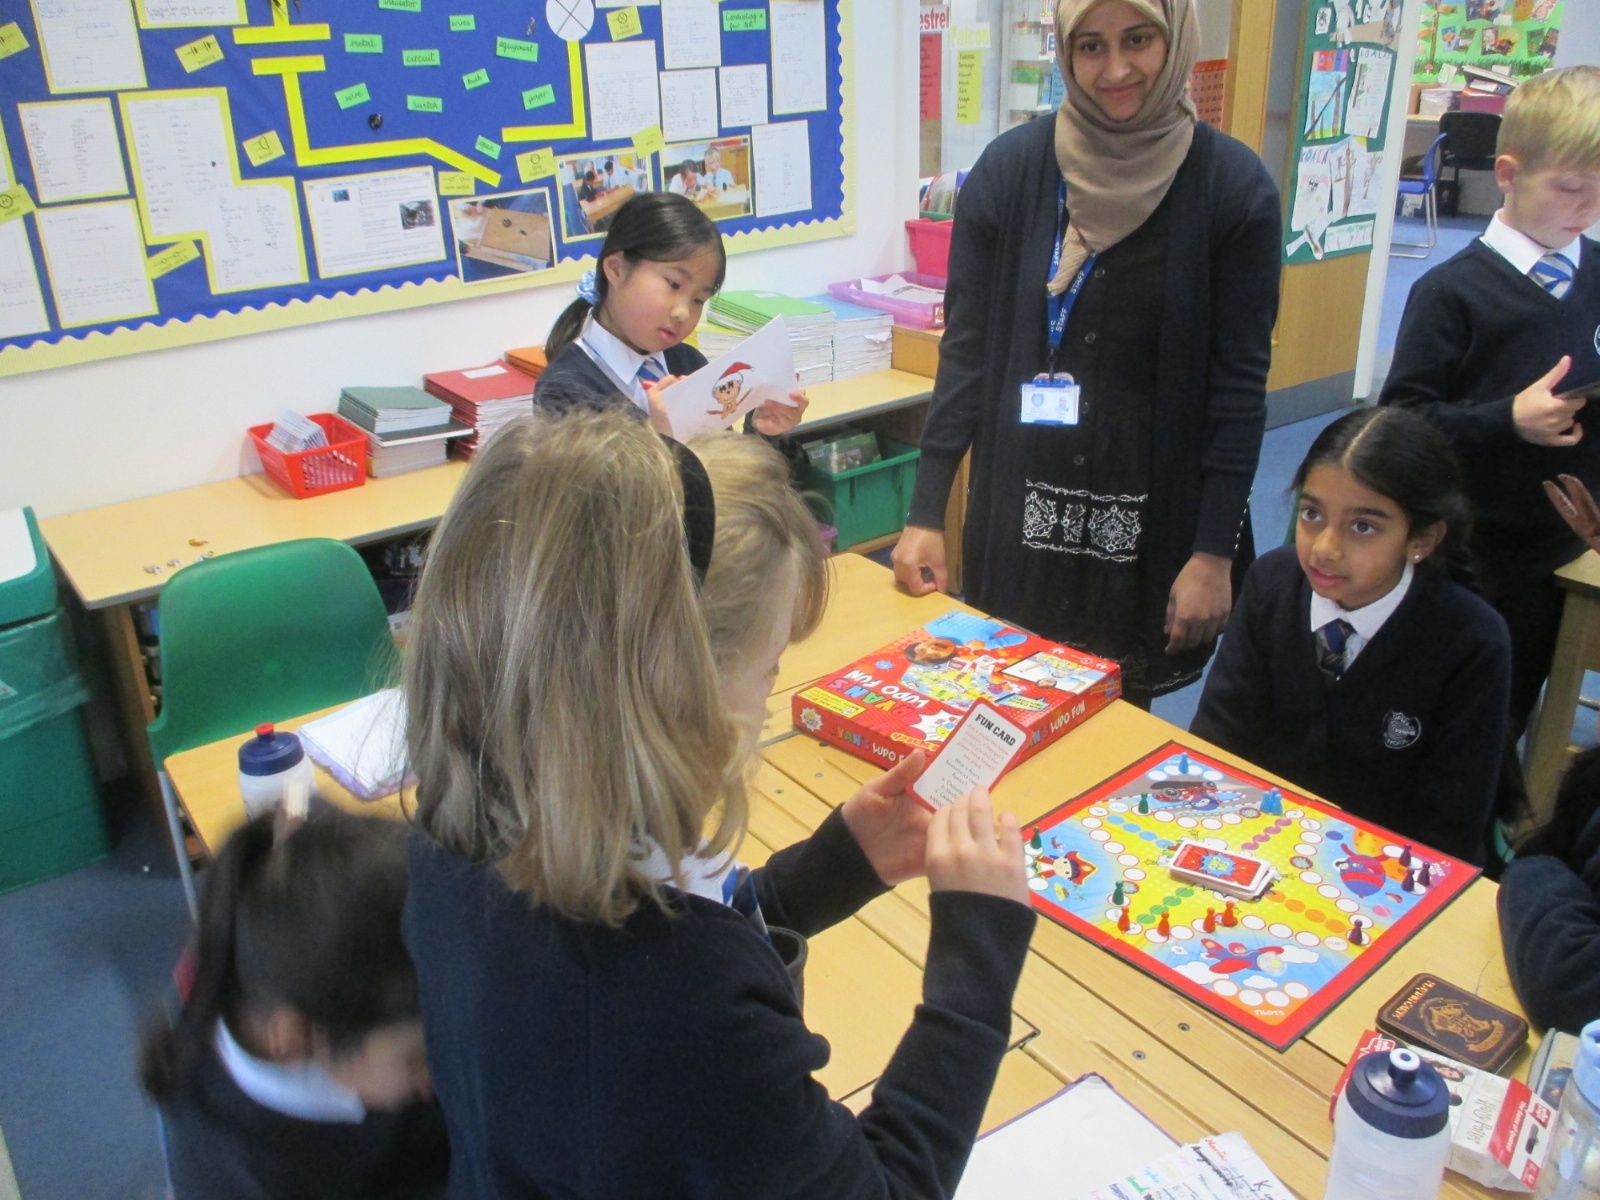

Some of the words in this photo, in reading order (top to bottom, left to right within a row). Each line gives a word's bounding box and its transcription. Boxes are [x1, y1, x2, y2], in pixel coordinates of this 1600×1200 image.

[351, 39, 375, 48] metal
[499, 42, 534, 53] equipment
[406, 52, 435, 63] circuit
[1070, 269, 1085, 294] STAFF
[1055, 307, 1068, 332] STAFF
[843, 669, 883, 688] FUN
[881, 685, 930, 709] LUDO
[1050, 712, 1070, 734] LUDO
[1071, 699, 1086, 719] FUN
[975, 713, 994, 731] FUN
[992, 726, 1016, 747] CARD
[872, 742, 896, 762] LUDO
